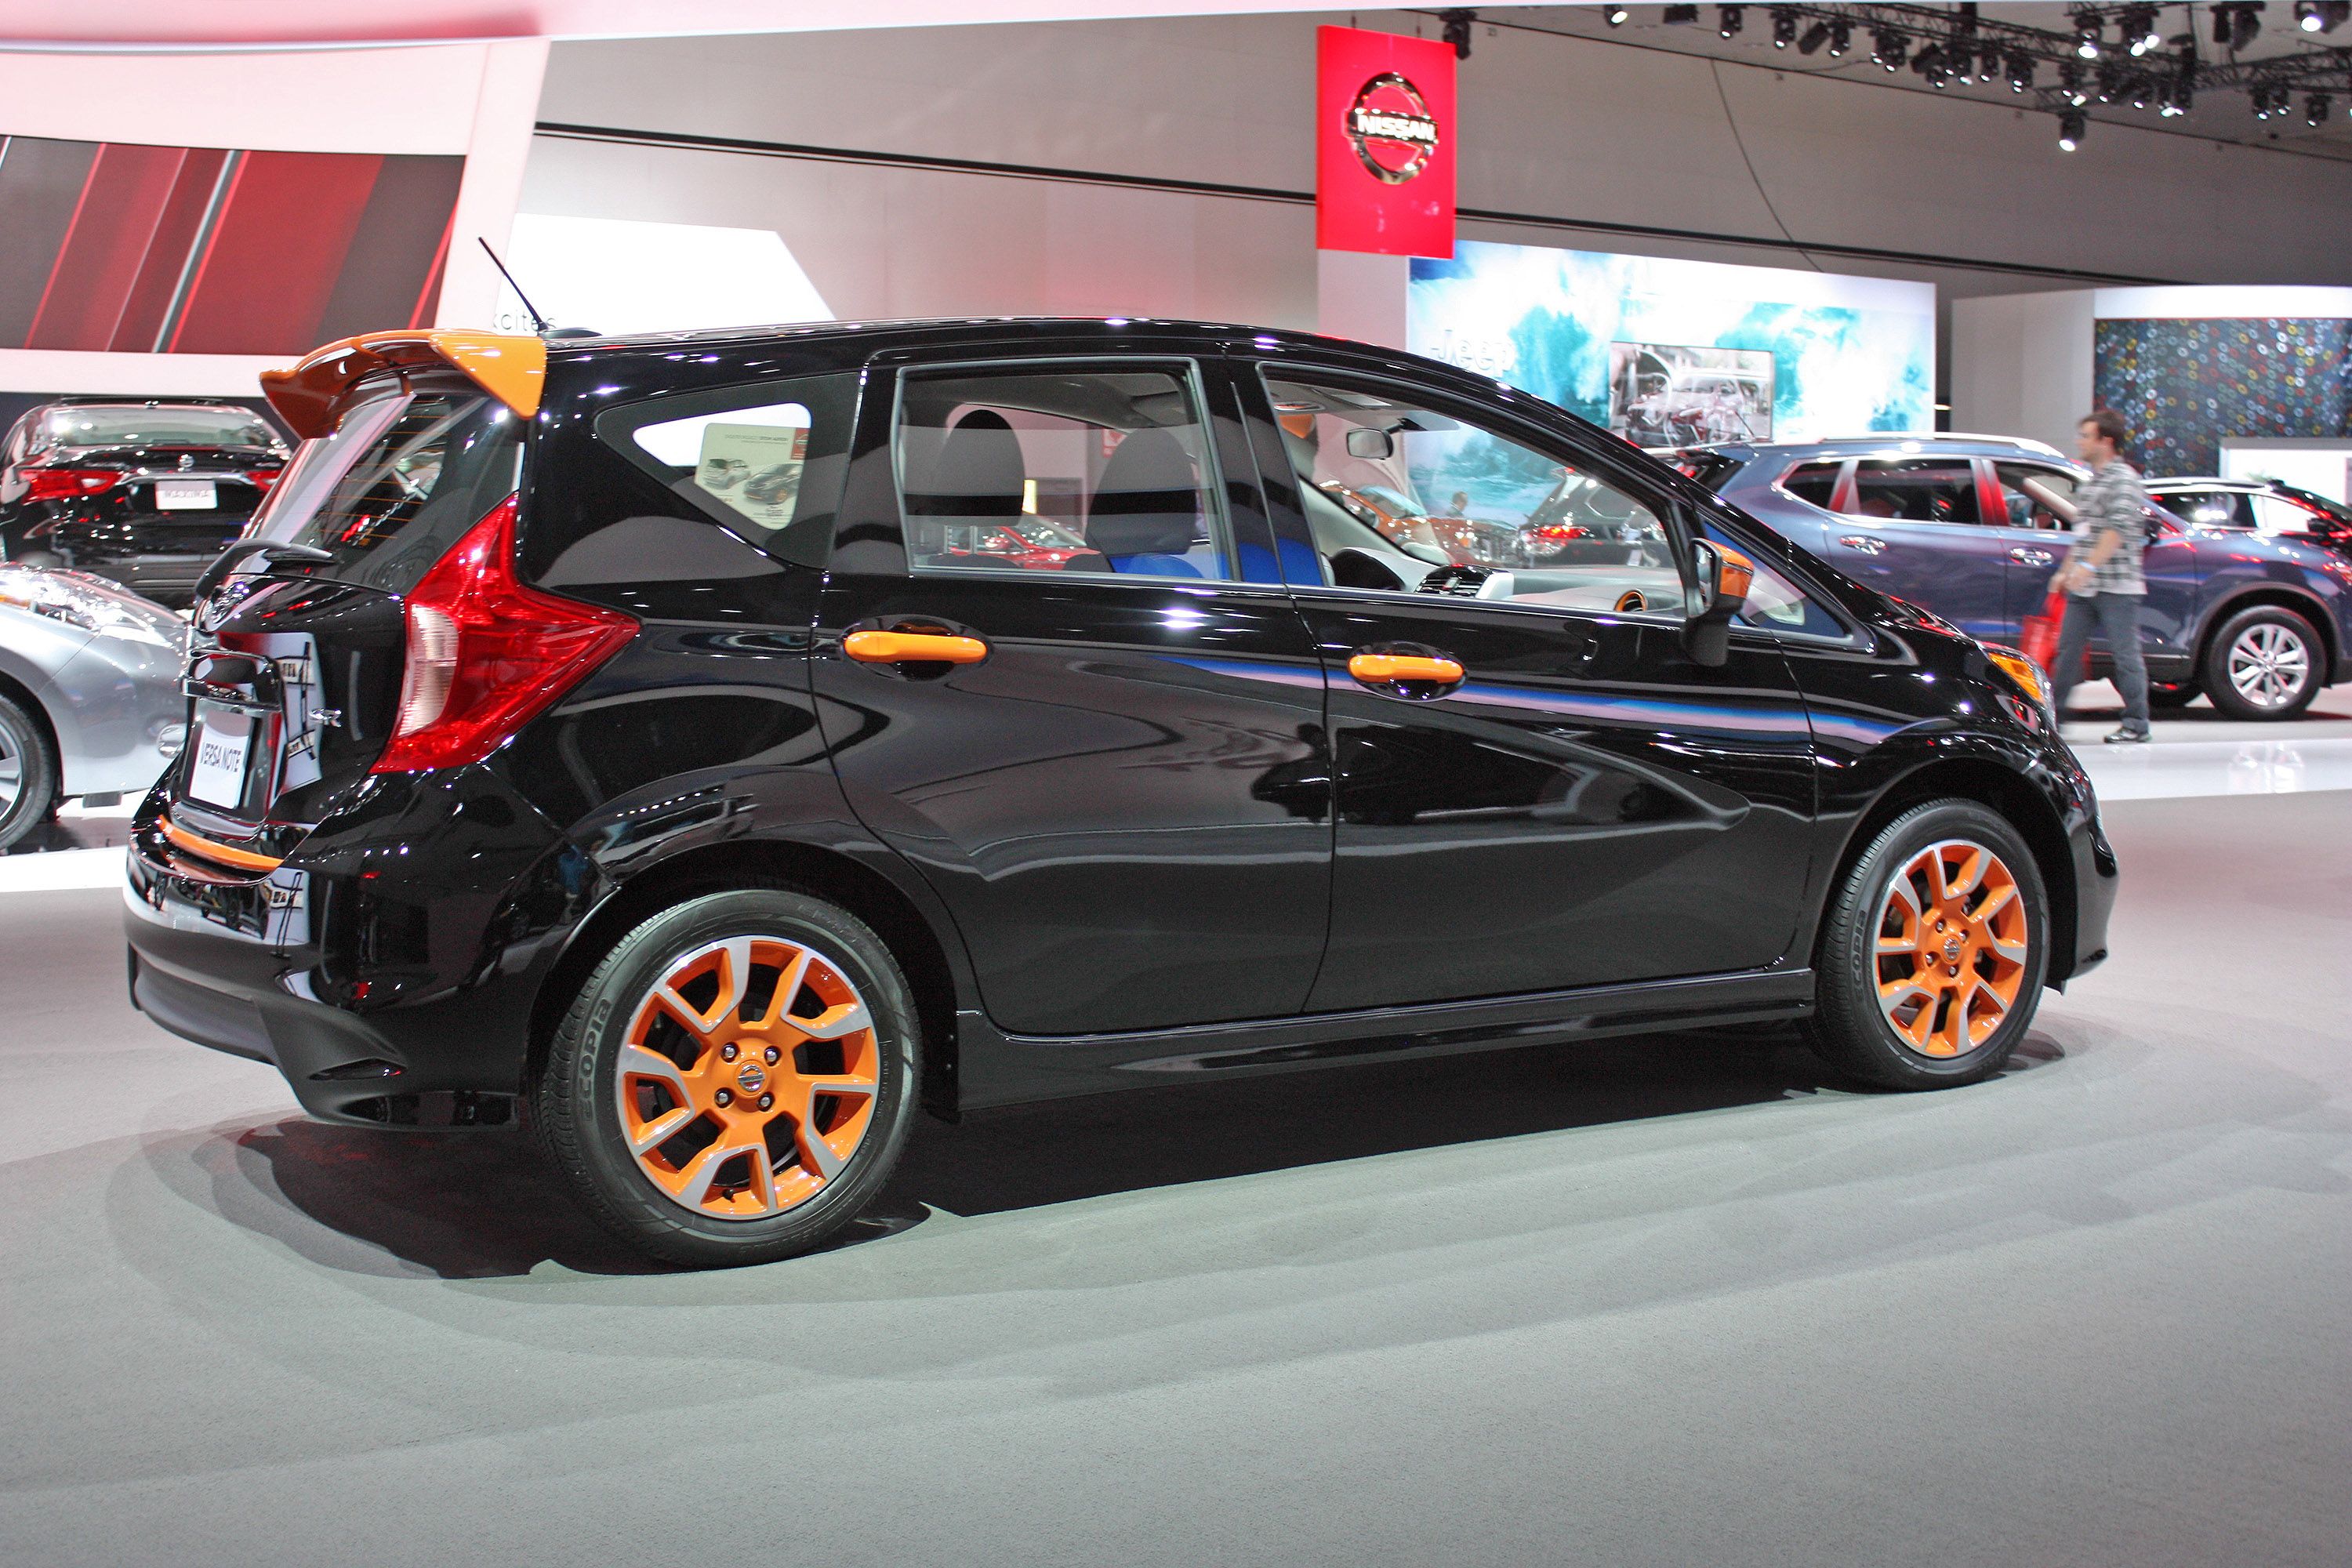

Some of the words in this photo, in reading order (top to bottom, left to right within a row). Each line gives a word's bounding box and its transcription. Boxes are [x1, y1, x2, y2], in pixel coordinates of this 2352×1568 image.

[1357, 114, 1435, 141] NISSAN
[1430, 329, 1515, 379] Jeep
[200, 742, 223, 768] VERSA
[222, 747, 241, 772] NOTE
